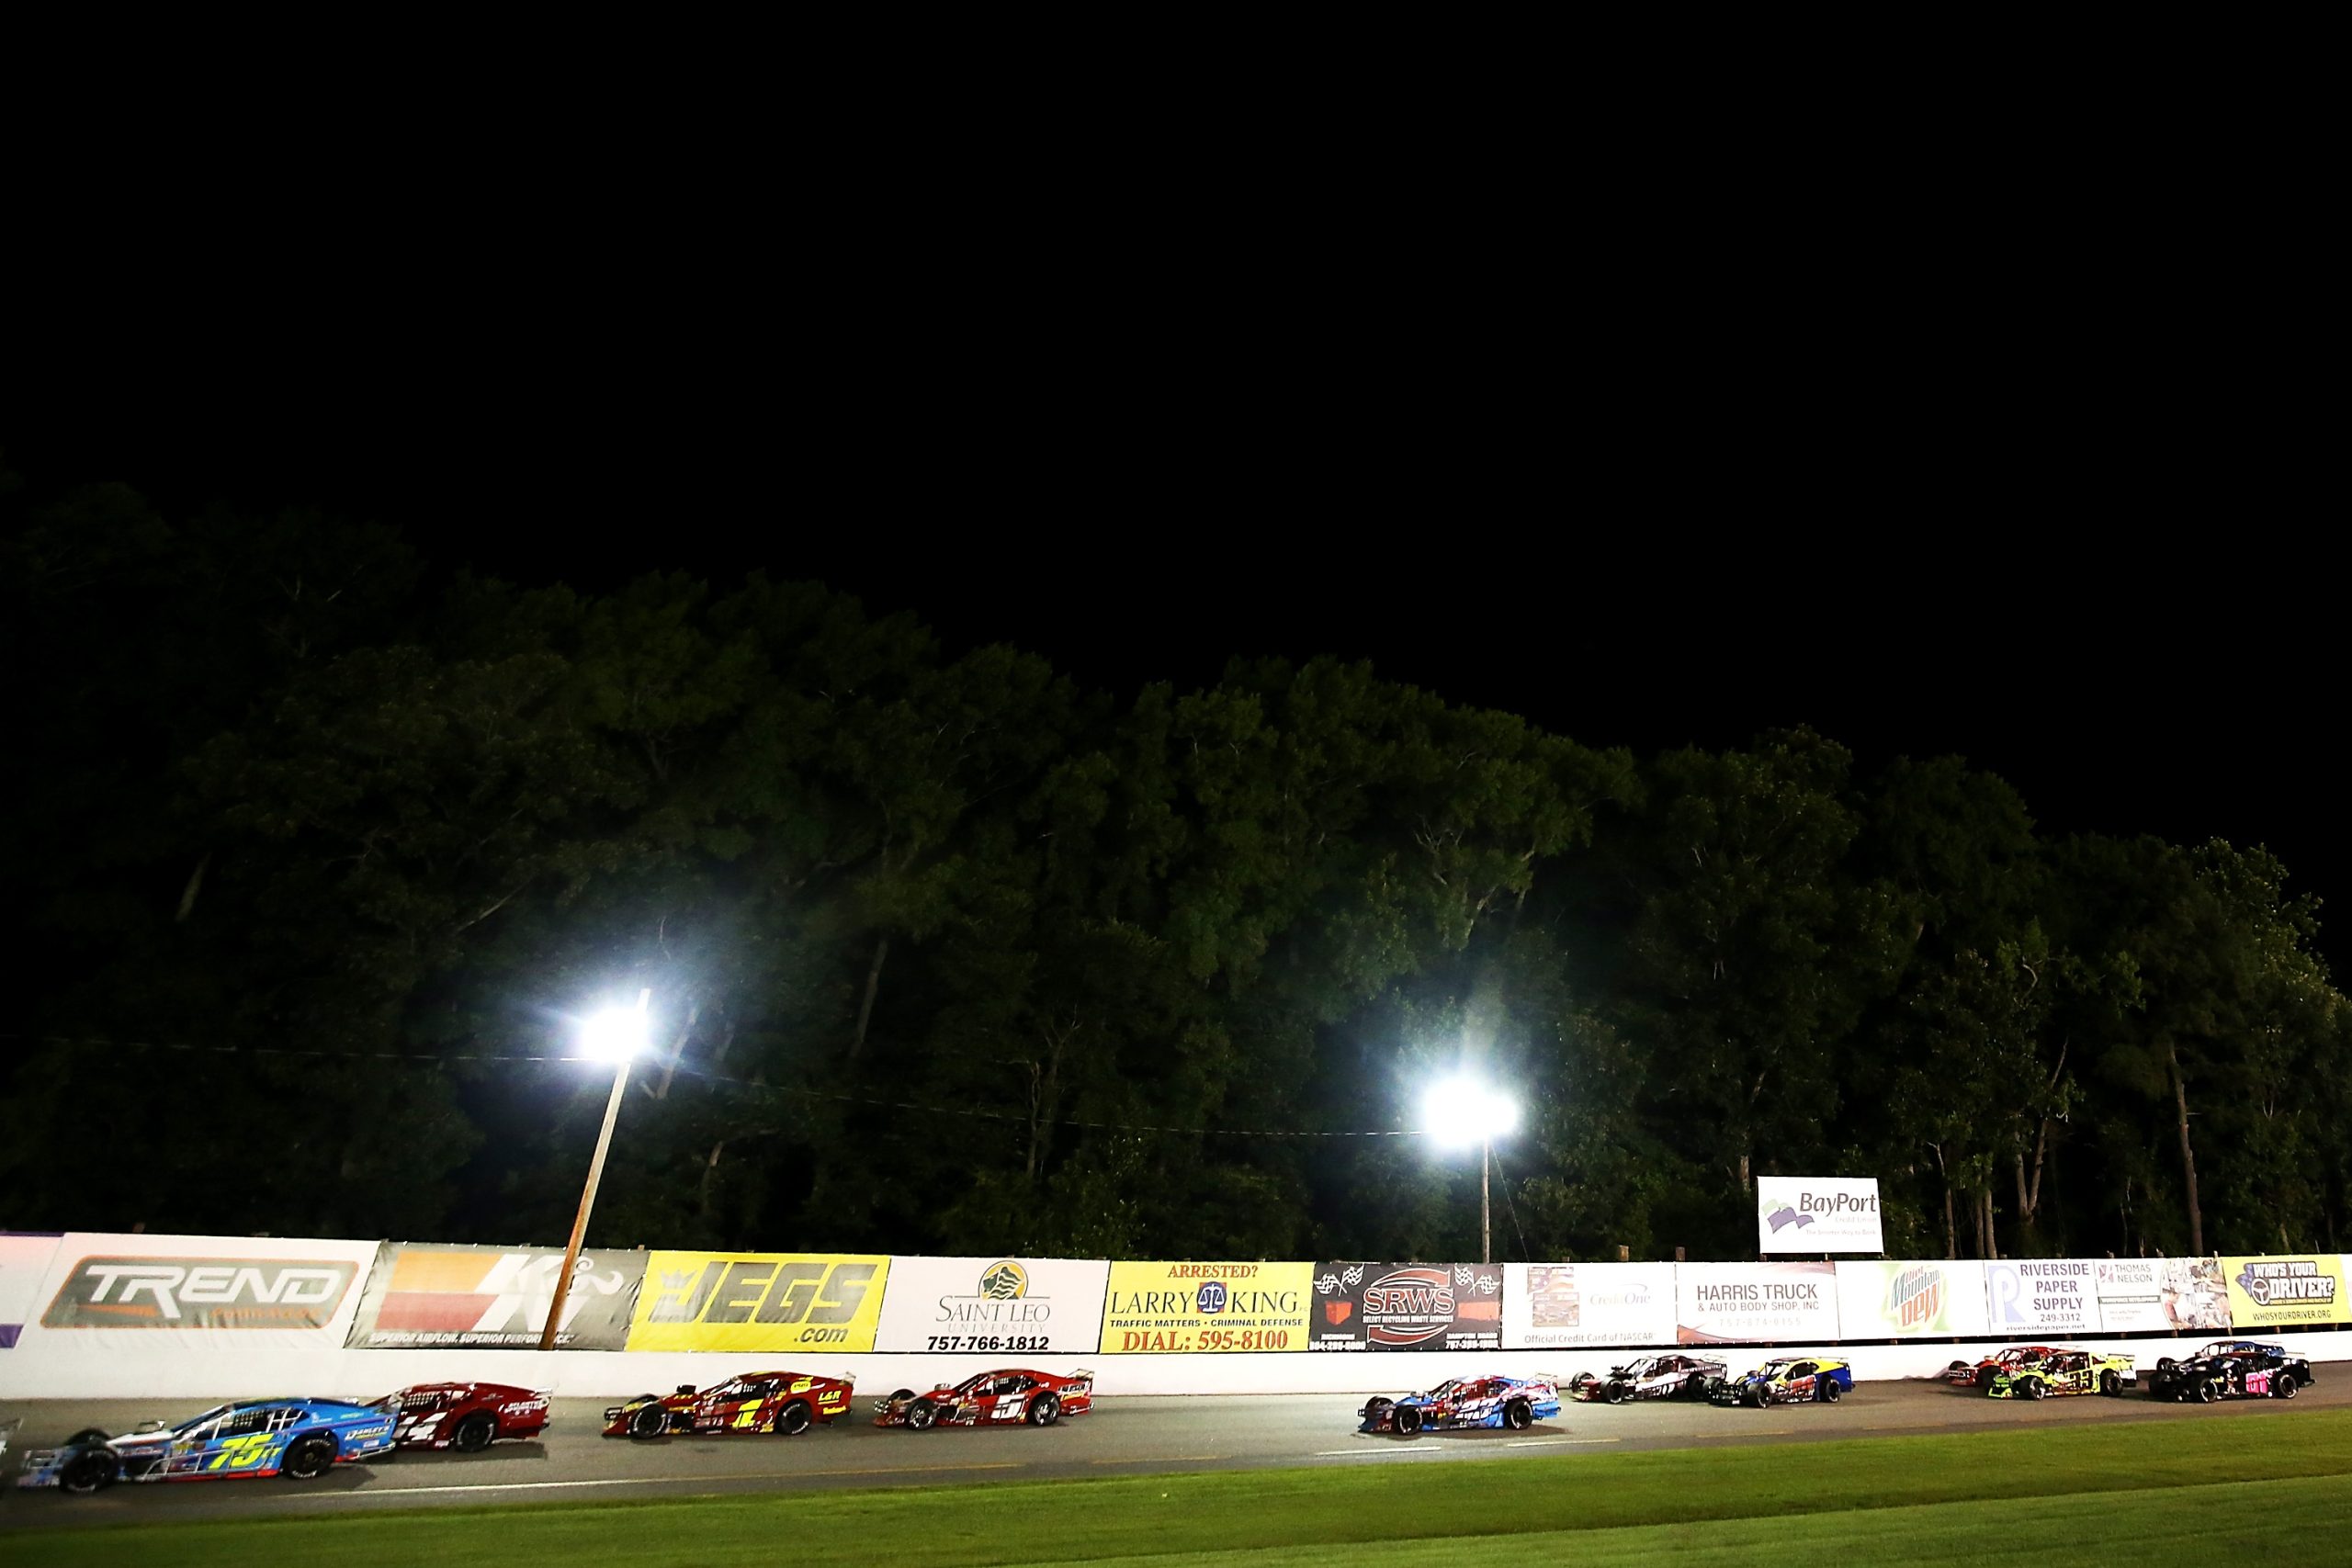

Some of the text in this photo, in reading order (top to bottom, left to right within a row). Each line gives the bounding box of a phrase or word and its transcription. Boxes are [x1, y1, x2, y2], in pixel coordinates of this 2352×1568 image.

[1800, 1193, 1876, 1217] BayPort
[1168, 1265, 1259, 1278] ARRESTED?
[2020, 1264, 2089, 1276] RIVERSIDE
[2115, 1264, 2151, 1273] THOMAS
[2287, 1262, 2316, 1277] YOUR
[2117, 1274, 2153, 1282] NELSON
[86, 1265, 341, 1318] TREND
[648, 1261, 878, 1324] JEGS
[1697, 1284, 1817, 1301] HARRIS TRUCK
[2036, 1280, 2078, 1292] PAPER
[2268, 1277, 2335, 1299] DRIVER?
[1110, 1292, 1194, 1314] LARRY
[1231, 1292, 1298, 1314] KING
[1363, 1287, 1455, 1314] SRWS
[1698, 1303, 1704, 1312] &
[1710, 1302, 1736, 1312] AUTO
[1740, 1302, 1768, 1312] BODY
[1803, 1301, 1819, 1310] INC
[2033, 1297, 2083, 1310] SUPPLY
[936, 1295, 1050, 1322] SAINT LEO
[2041, 1314, 2081, 1322] 249-3312
[794, 1327, 848, 1342] .com
[948, 1324, 1046, 1333] UNIVERSITY
[369, 1333, 415, 1343] SUPERIOR
[459, 1334, 503, 1344] SUPERIOR
[928, 1336, 1049, 1350] 757-766-1812
[1122, 1330, 1288, 1351] DIAL: 595-8100
[1524, 1332, 1654, 1343] Official Credit Card of NASCAR
[209, 1433, 275, 1470] 75
